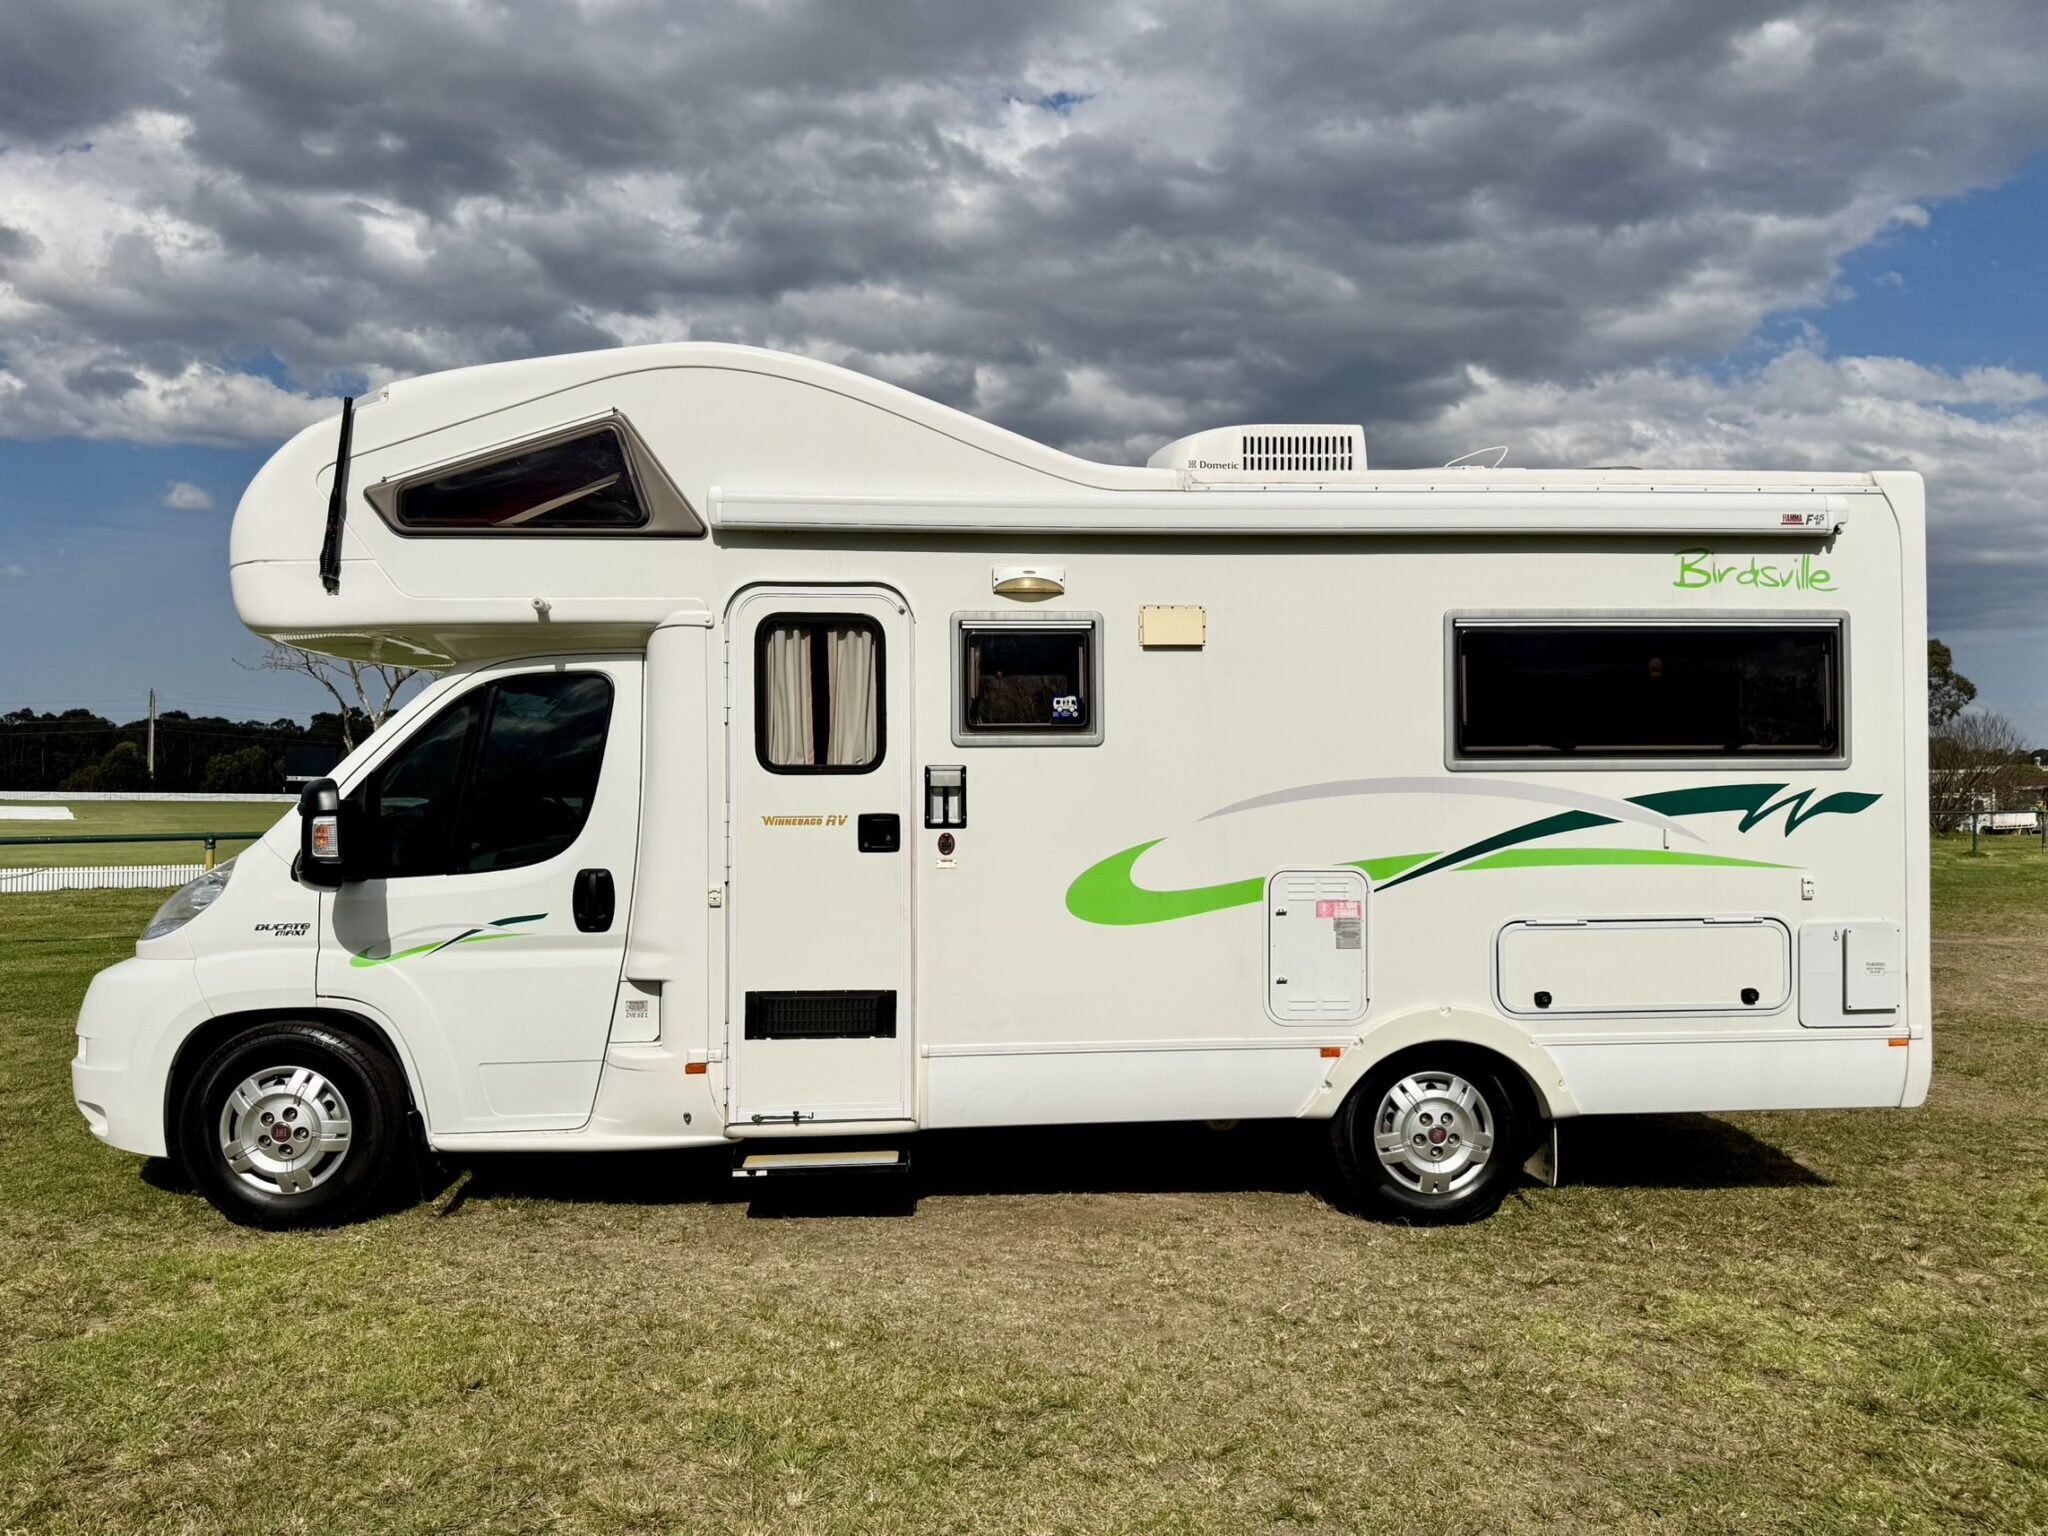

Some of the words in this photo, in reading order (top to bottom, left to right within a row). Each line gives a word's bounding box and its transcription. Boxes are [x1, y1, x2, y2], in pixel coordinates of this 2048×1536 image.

[1199, 460, 1240, 470] Dometic
[1782, 513, 1803, 522] FIAMMA
[1672, 547, 1839, 592] Birdsville
[761, 815, 824, 826] WINNEBAGO
[825, 814, 849, 826] RV
[254, 922, 311, 931] DUCATO
[274, 929, 307, 937] MAXI
